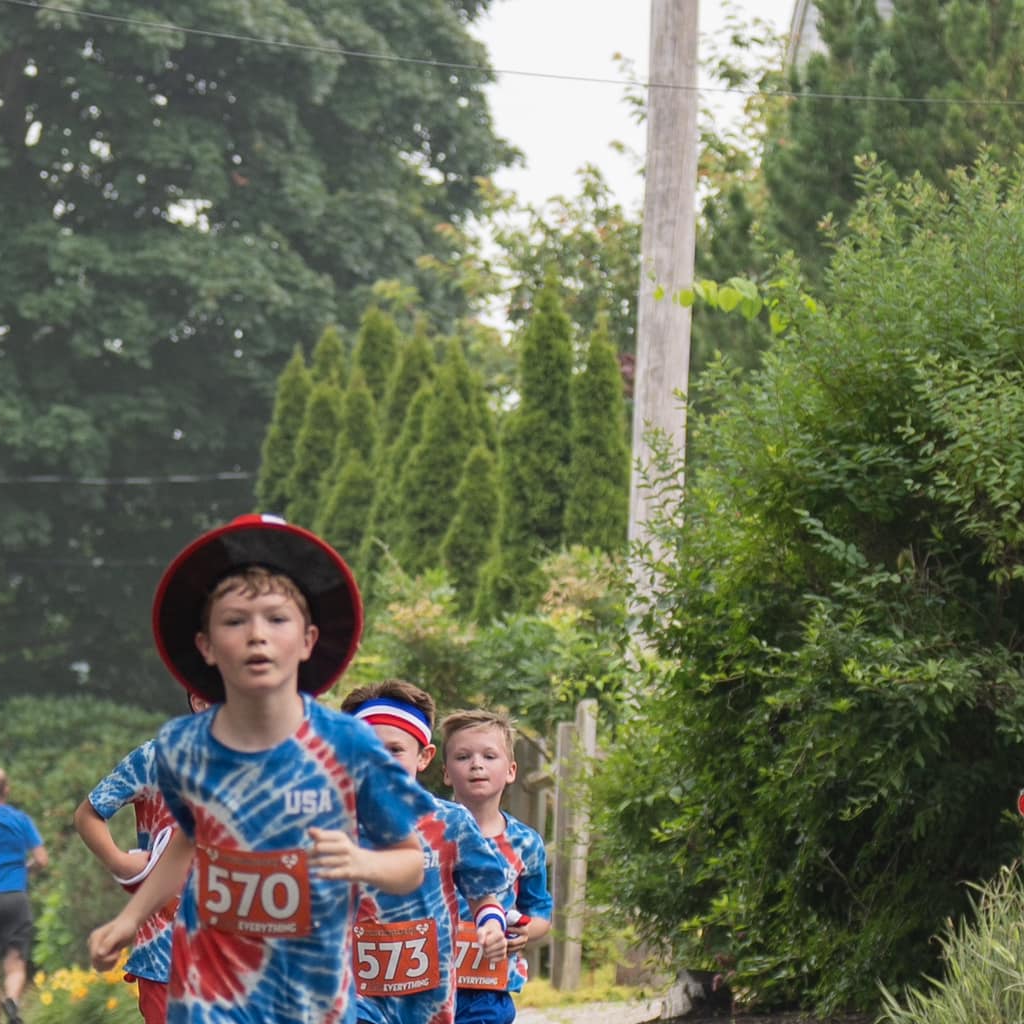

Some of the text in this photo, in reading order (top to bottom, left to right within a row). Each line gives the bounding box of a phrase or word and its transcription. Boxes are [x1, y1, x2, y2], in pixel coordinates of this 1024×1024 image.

[285, 789, 333, 815] USA
[422, 851, 440, 869] SA
[206, 864, 300, 919] 570
[238, 921, 297, 933] EVERYTHING
[357, 938, 429, 980] 573
[383, 978, 430, 992] EVERYTHING
[458, 976, 498, 985] EVERYTHING
